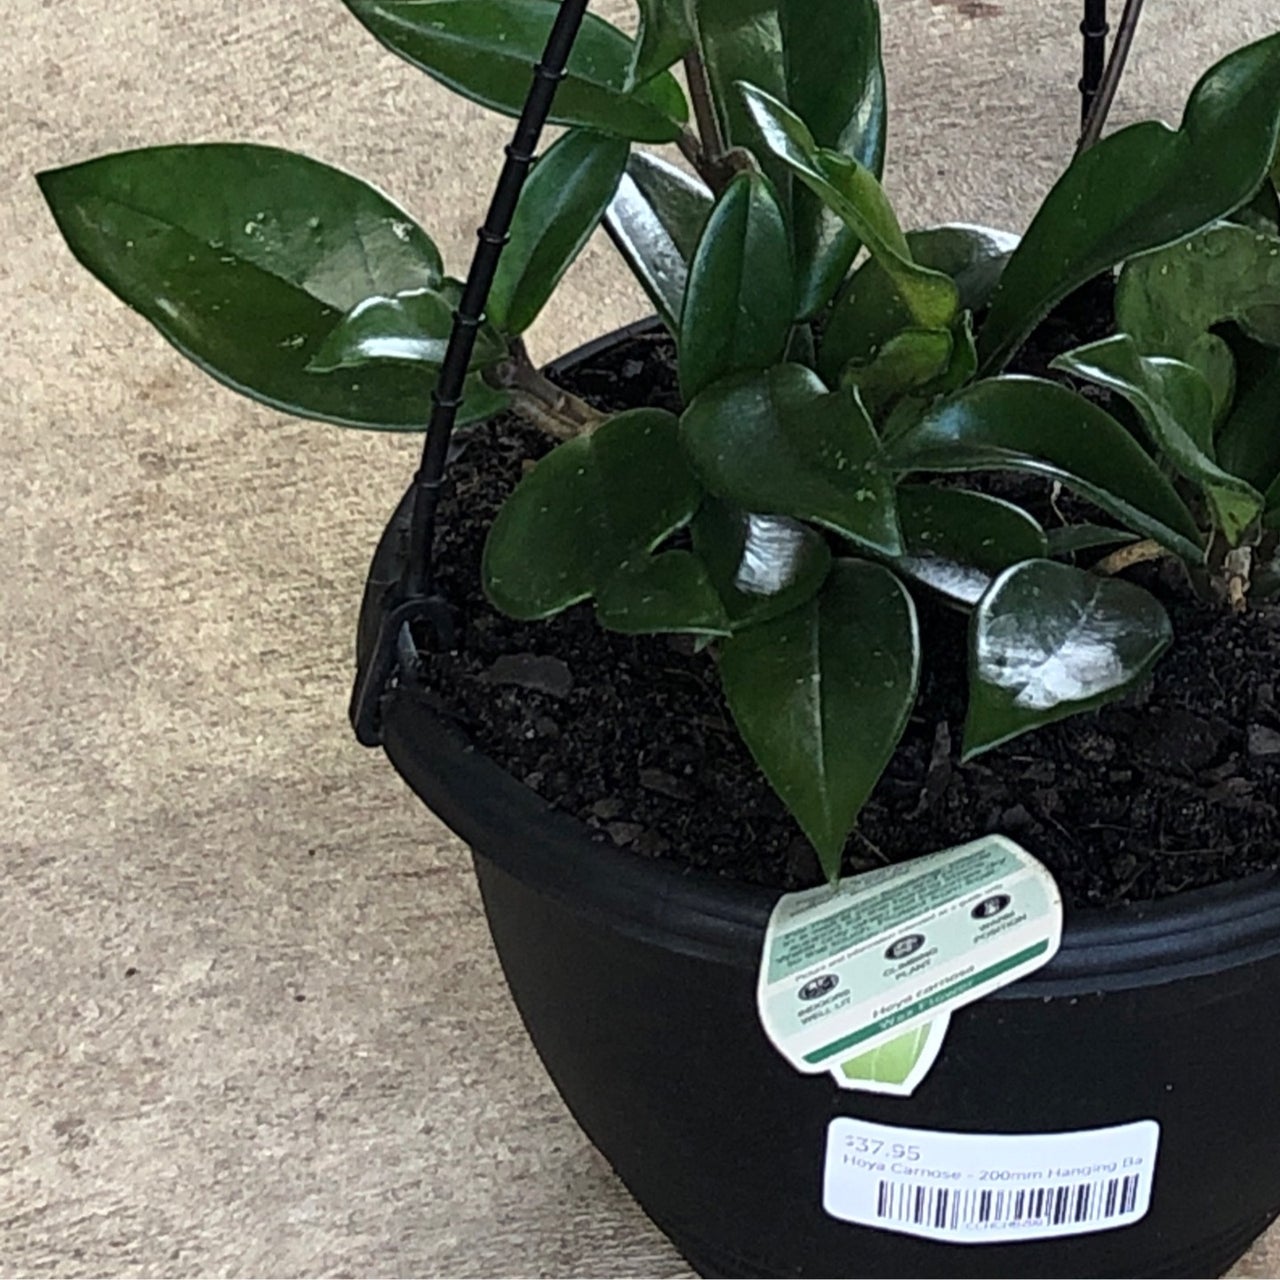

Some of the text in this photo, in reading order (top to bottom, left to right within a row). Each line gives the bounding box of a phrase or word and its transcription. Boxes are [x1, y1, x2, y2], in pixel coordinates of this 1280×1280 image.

[894, 959, 932, 980] PLANT
[871, 994, 913, 1019] Hoya
[845, 1134, 921, 1162] $37.95
[843, 1153, 886, 1171] Hoya
[978, 1169, 1043, 1182] 200mm
[1048, 1161, 1118, 1179] Hanging
[1123, 1156, 1144, 1168] Ba
